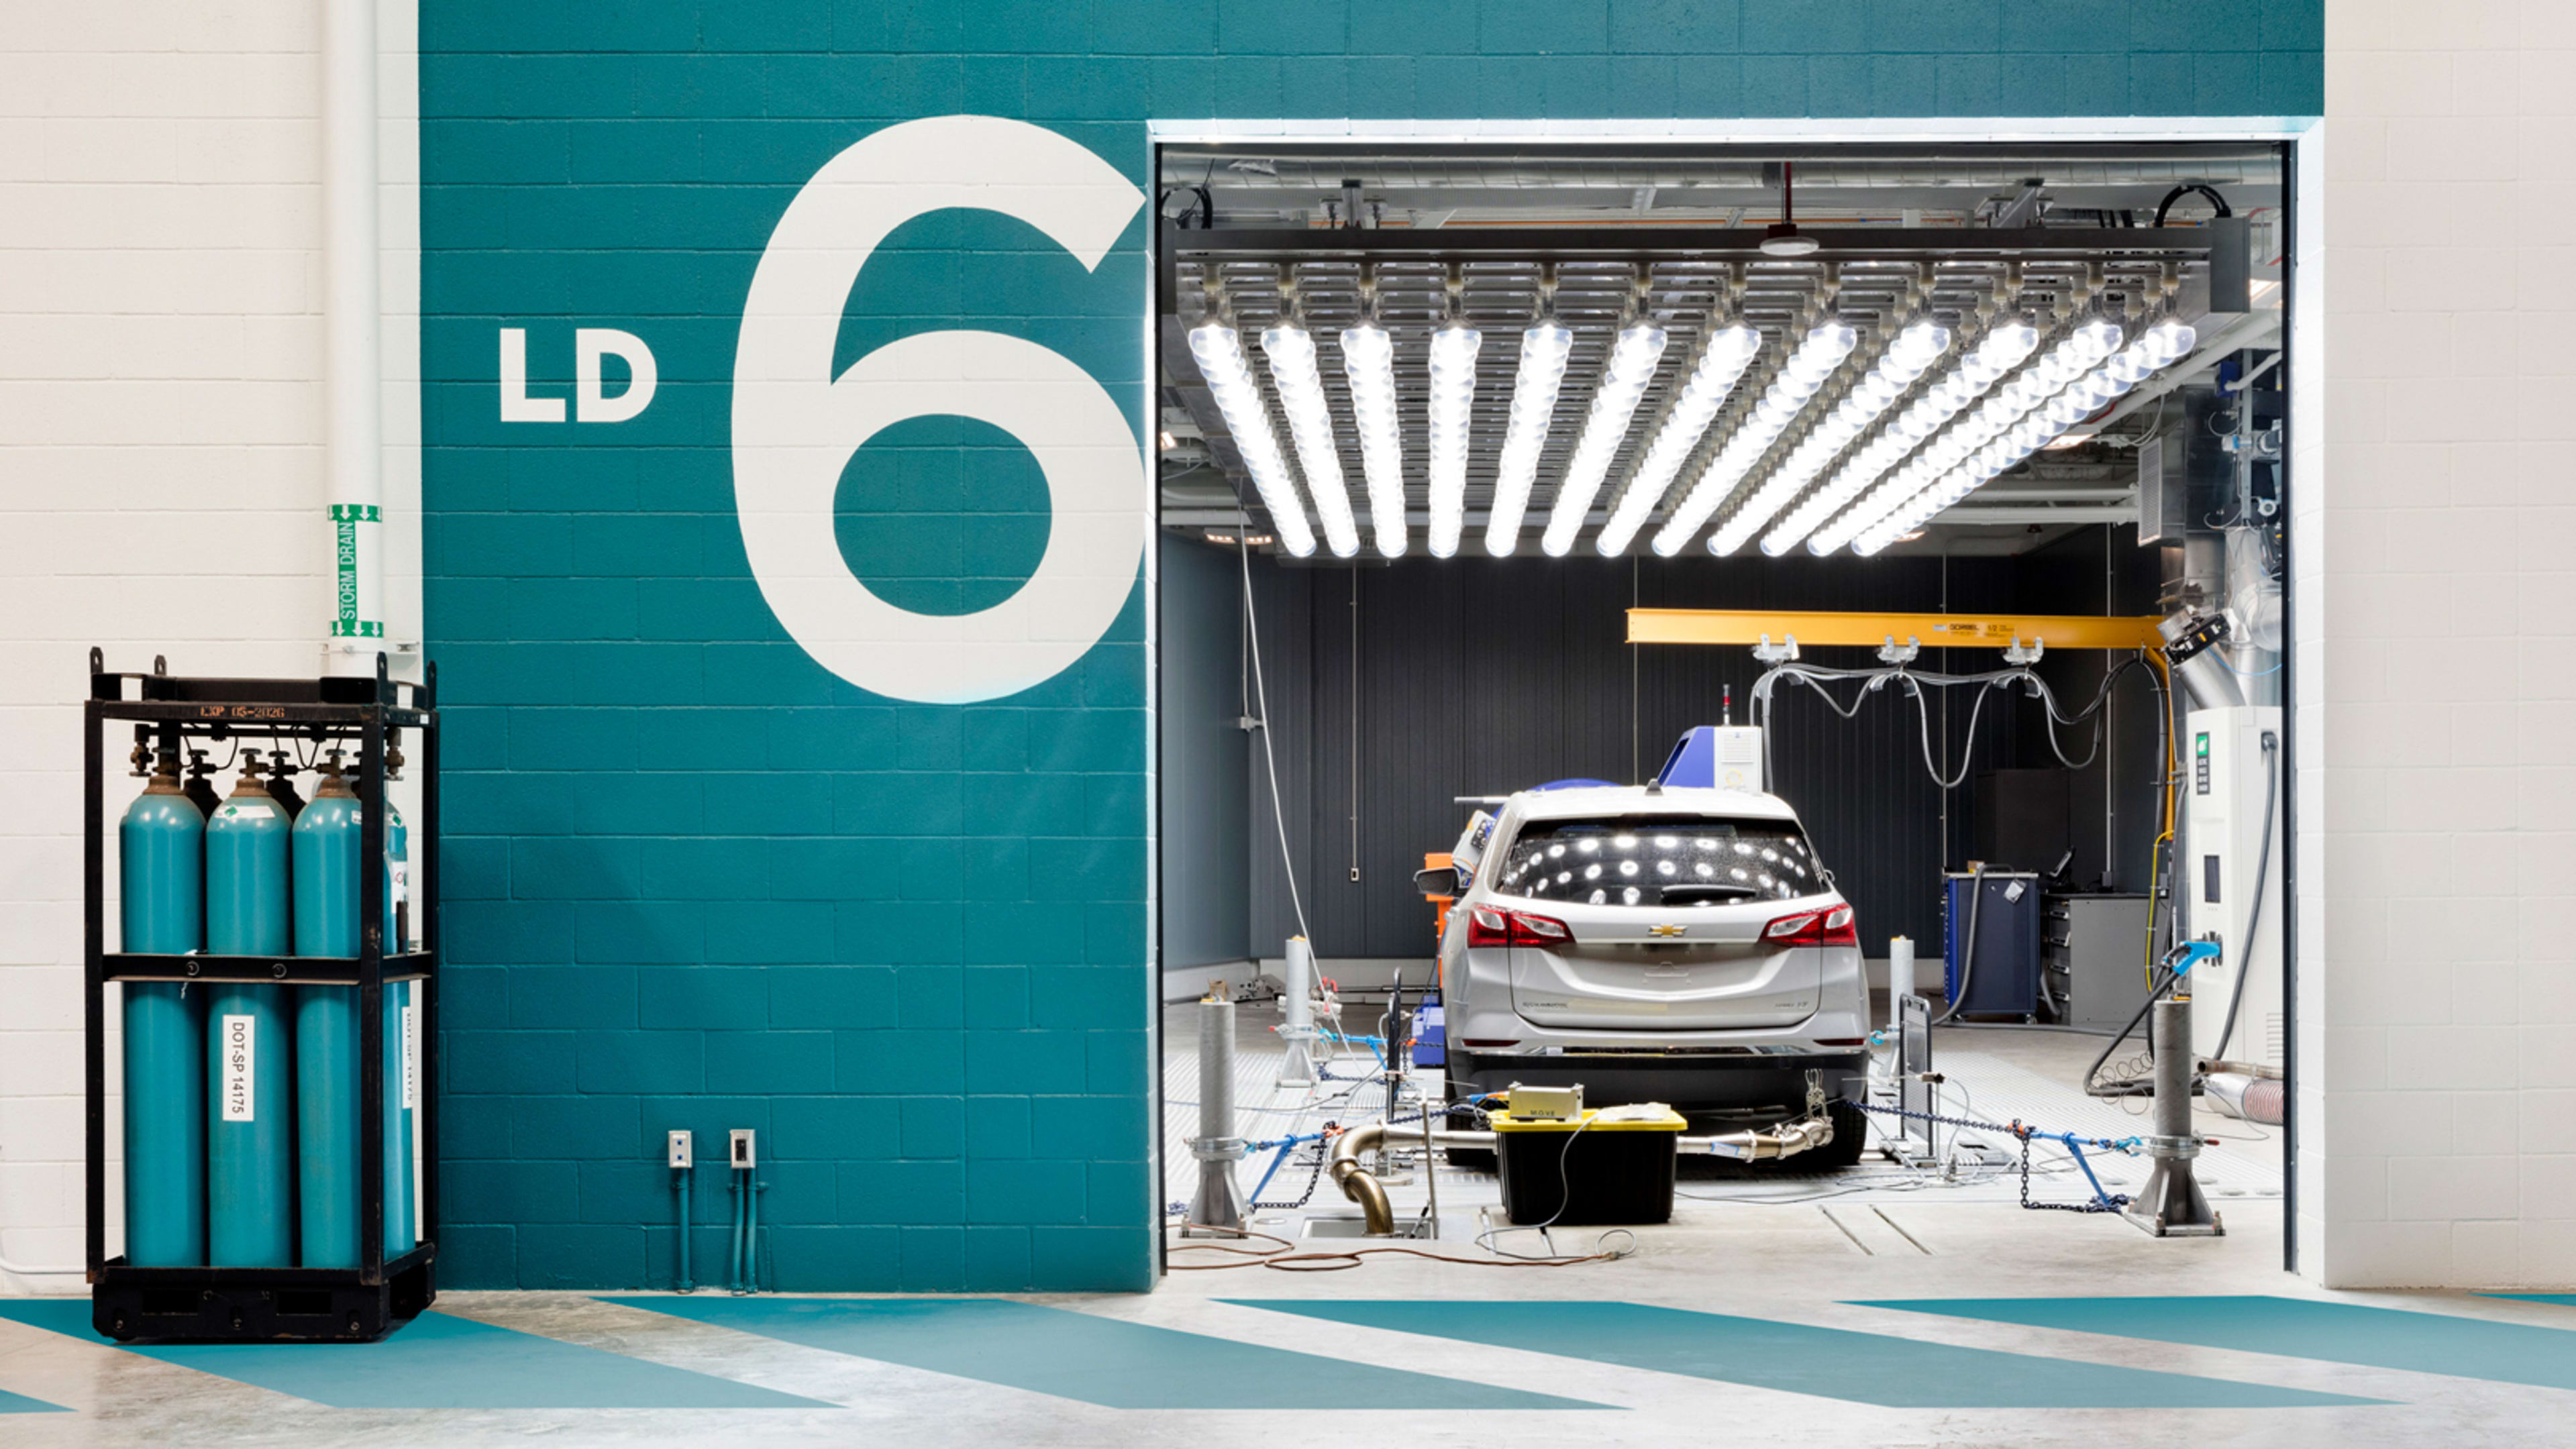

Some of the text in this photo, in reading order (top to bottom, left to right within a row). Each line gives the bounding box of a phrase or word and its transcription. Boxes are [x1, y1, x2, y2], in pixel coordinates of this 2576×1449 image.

[499, 113, 1146, 705] LD 6
[338, 521, 356, 620] STORM DRAIN
[231, 1022, 246, 1114] DOT-SP 14175
